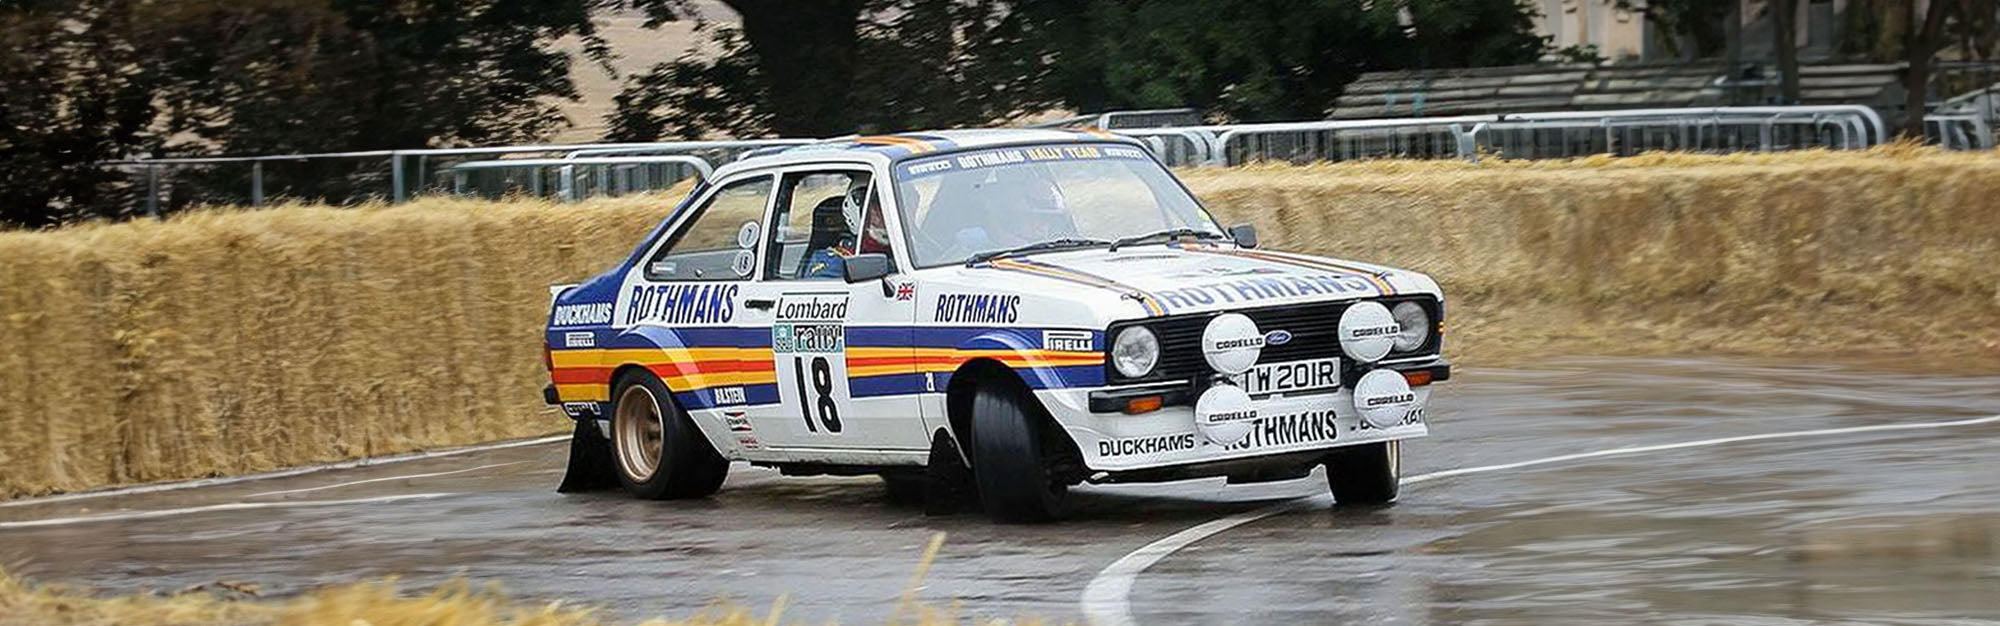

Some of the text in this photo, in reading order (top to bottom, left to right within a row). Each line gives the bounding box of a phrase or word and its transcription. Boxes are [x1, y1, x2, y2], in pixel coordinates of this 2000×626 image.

[626, 284, 739, 325] ROTHMANS
[1155, 274, 1368, 308] ROTHMANS
[554, 302, 613, 326] DUCKHAMS
[776, 296, 849, 319] Lombard
[934, 293, 1020, 324] ROTHMANS
[796, 326, 838, 350] rally
[1043, 330, 1093, 351] PIRELLI
[1277, 361, 1334, 389] 201R
[794, 356, 842, 433] 18
[1100, 433, 1195, 457] DUCKHAMS
[1225, 409, 1337, 451] THMANS
